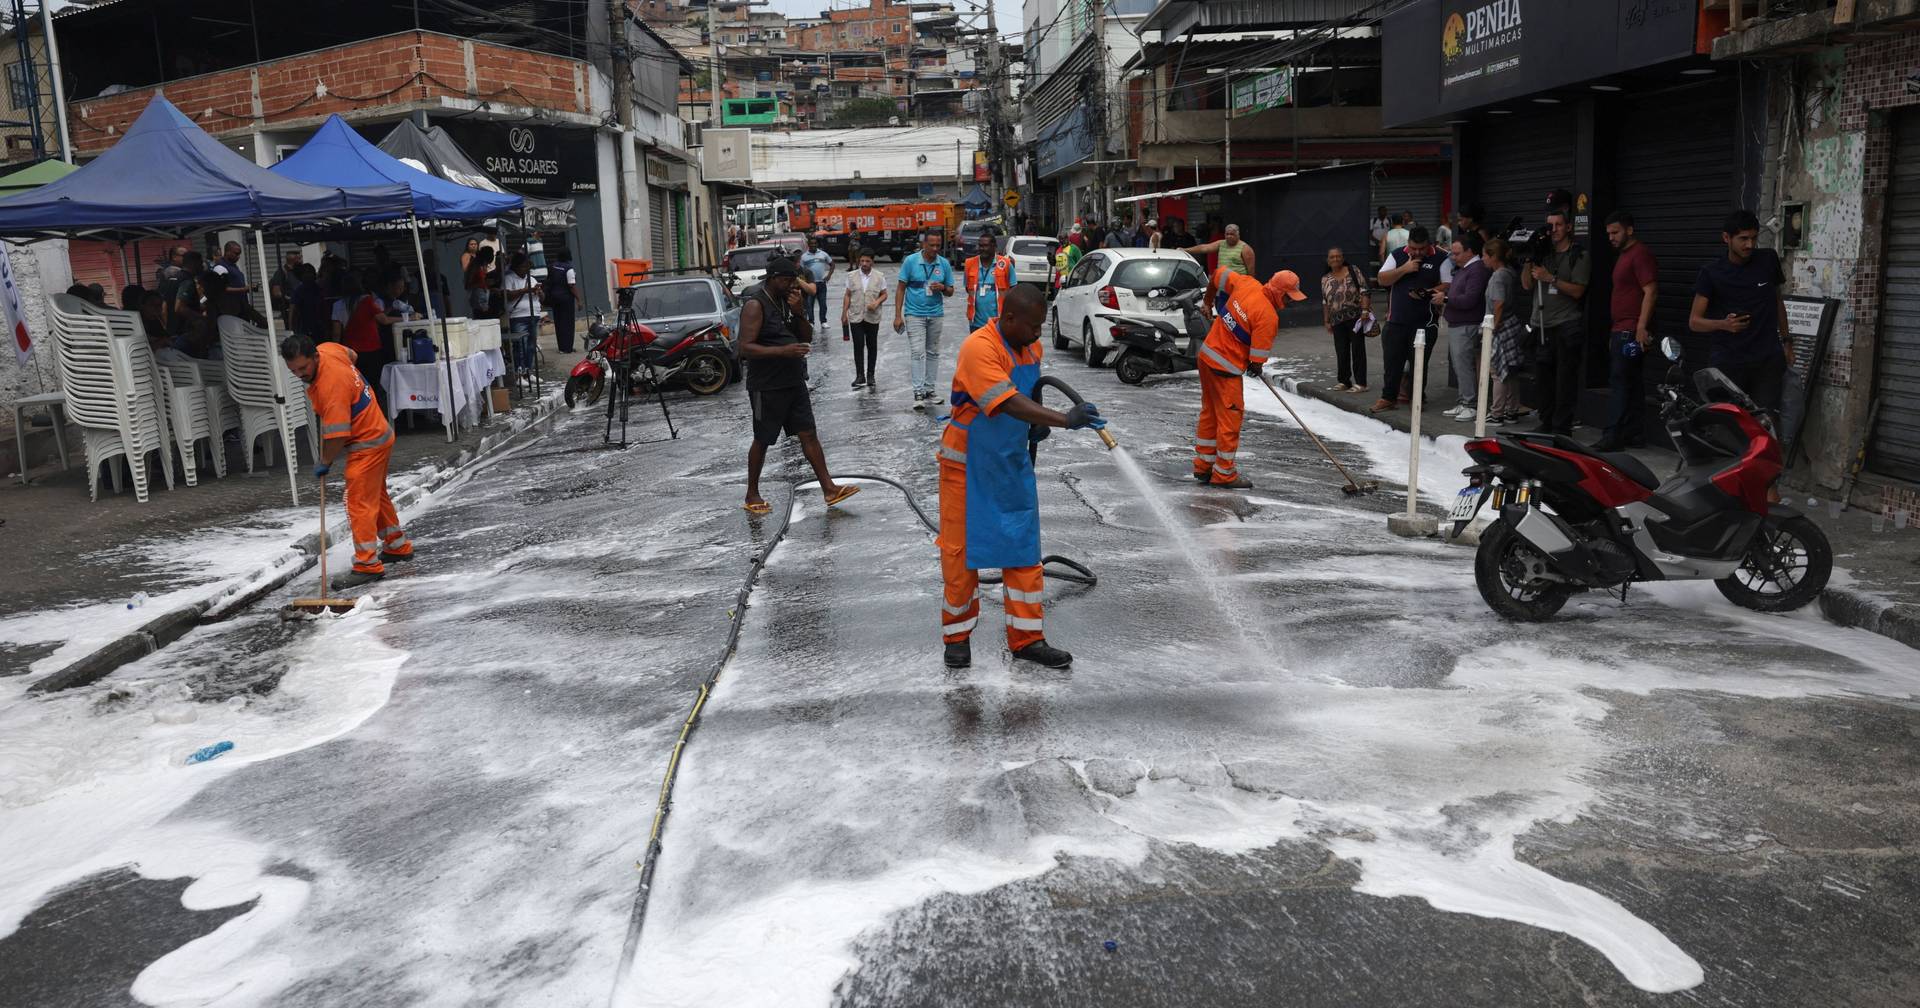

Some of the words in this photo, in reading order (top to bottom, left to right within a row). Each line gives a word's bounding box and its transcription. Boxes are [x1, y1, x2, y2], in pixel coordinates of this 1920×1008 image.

[1466, 0, 1522, 43] PENHA
[1465, 28, 1521, 56] MULTIMARCAS
[486, 156, 517, 173] SARA
[519, 158, 559, 175] SOARES
